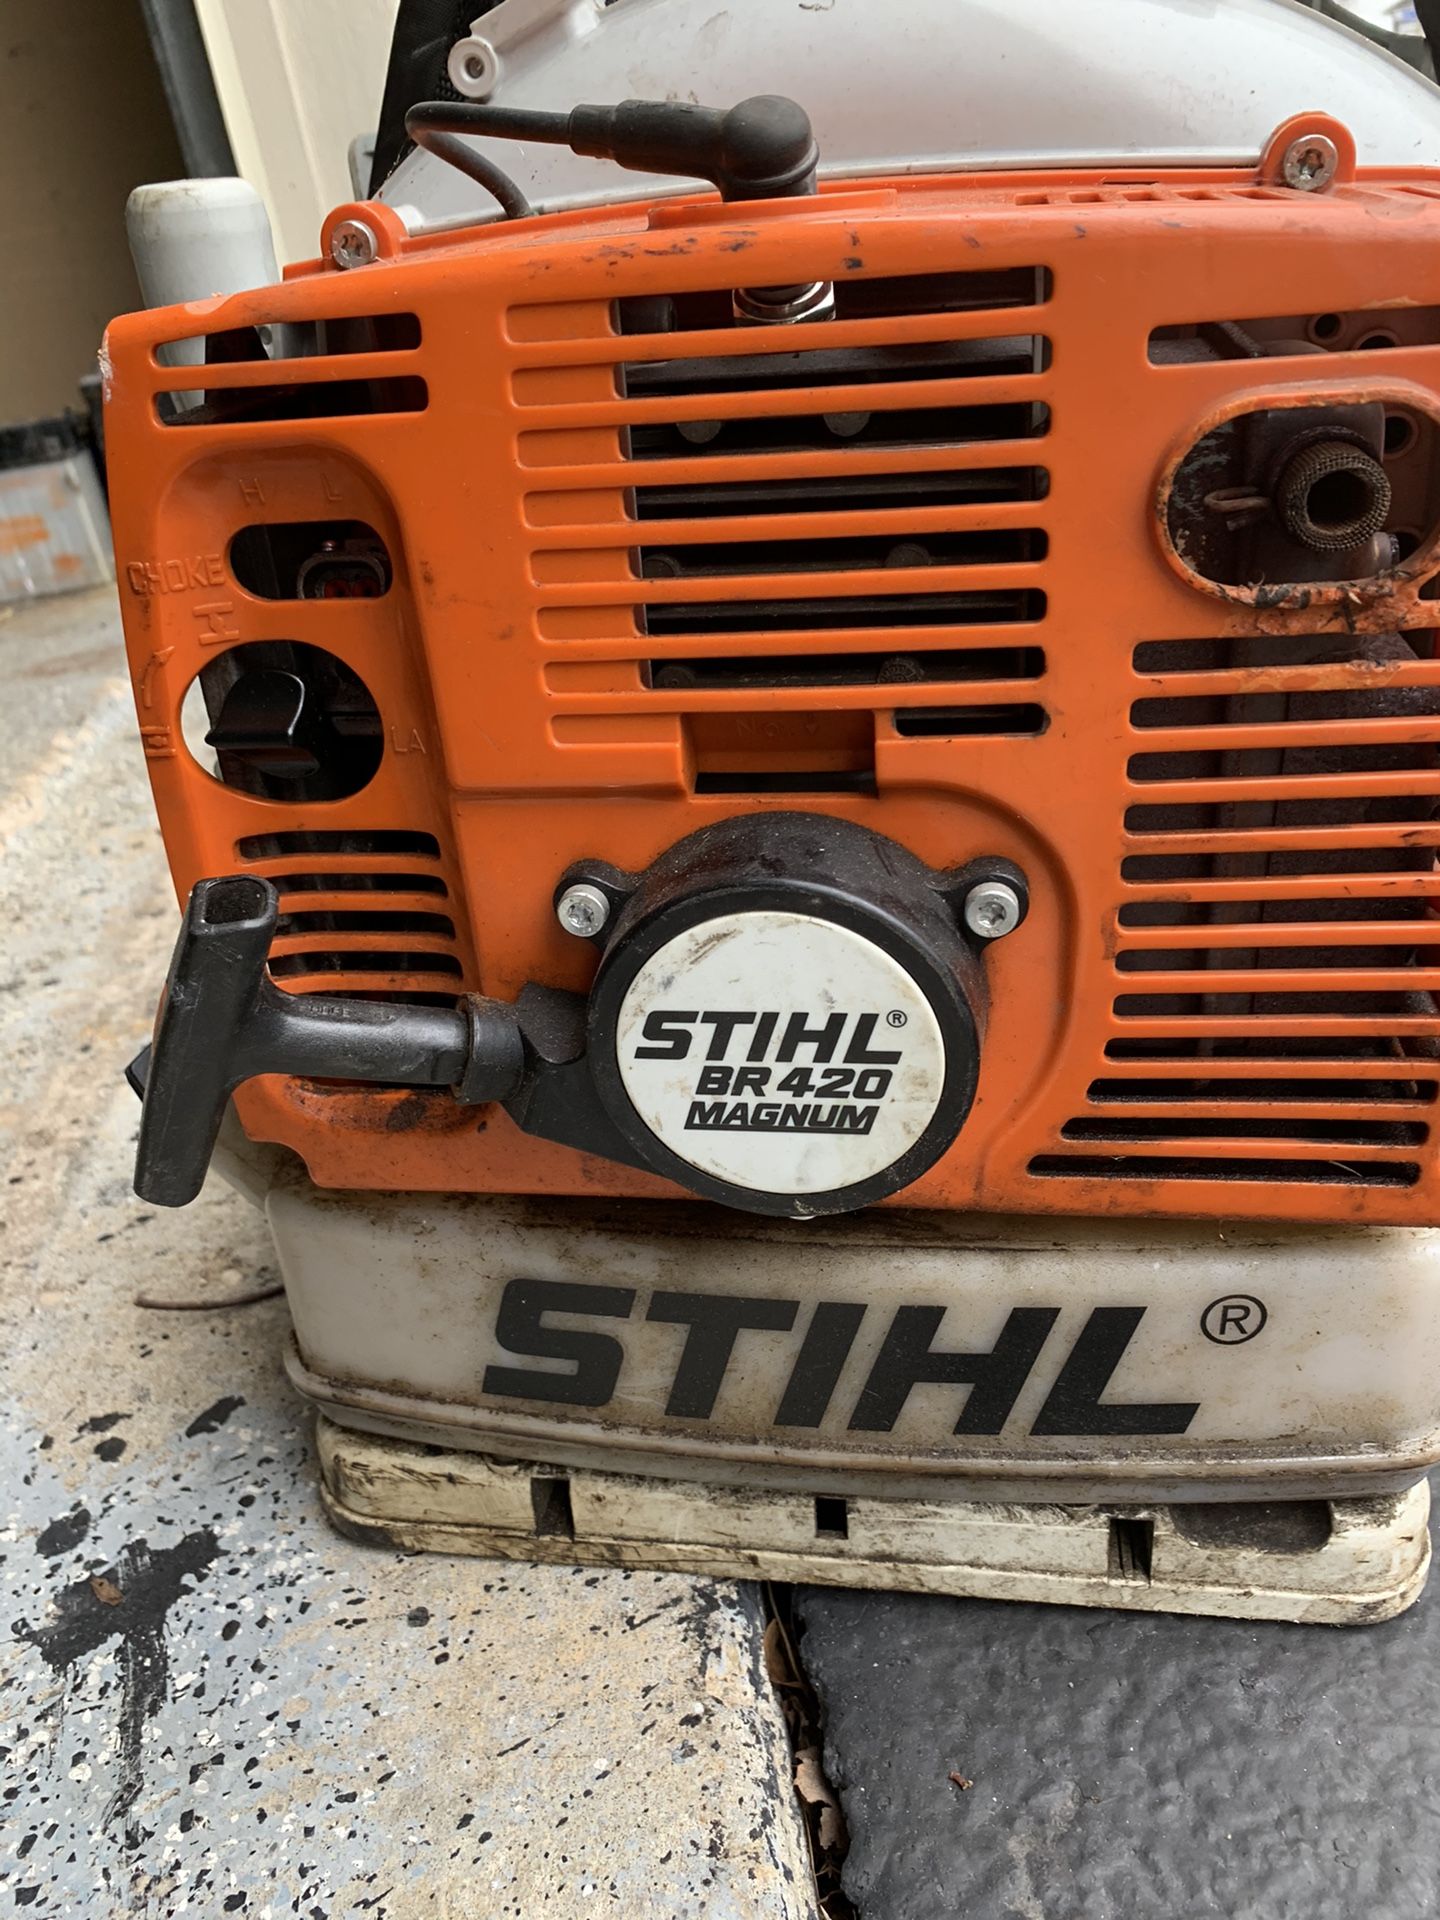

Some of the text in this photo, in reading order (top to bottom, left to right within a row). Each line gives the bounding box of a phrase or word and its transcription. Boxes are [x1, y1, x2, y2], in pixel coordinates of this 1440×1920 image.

[238, 477, 265, 506] H
[126, 553, 226, 595] CHOKE
[684, 1101, 880, 1134] MAGNUM
